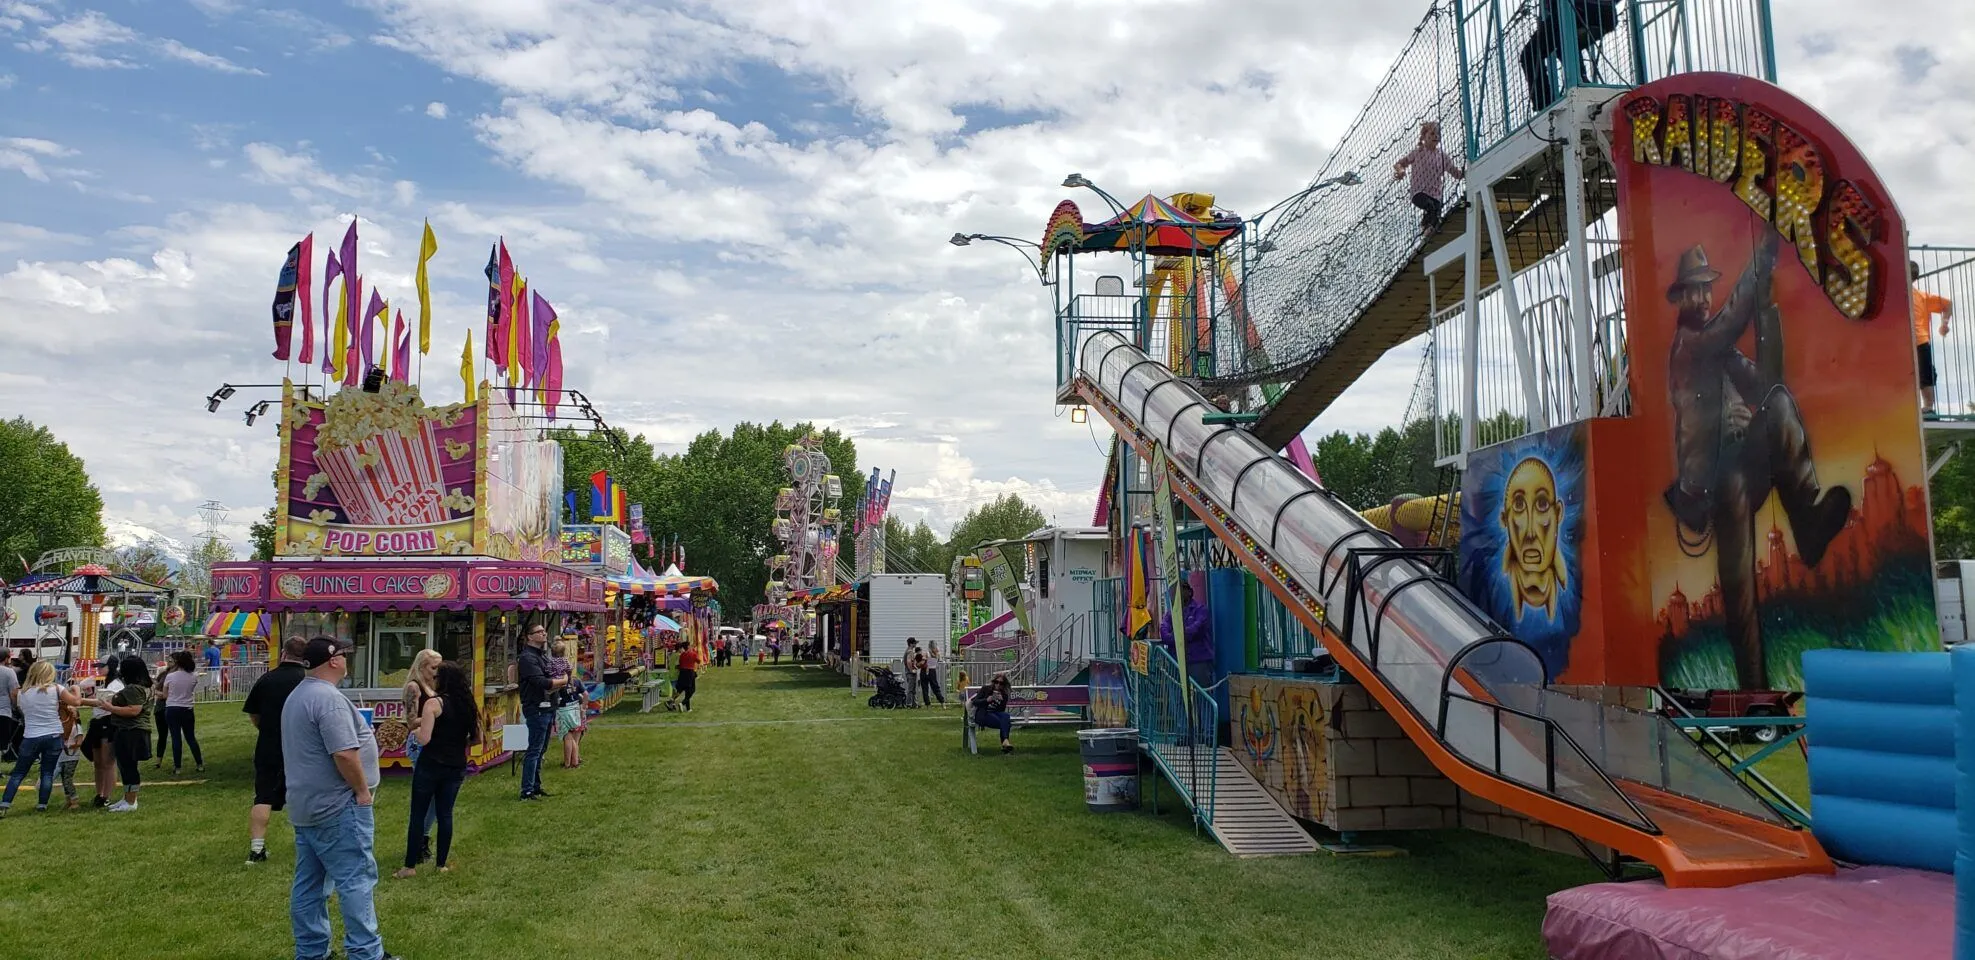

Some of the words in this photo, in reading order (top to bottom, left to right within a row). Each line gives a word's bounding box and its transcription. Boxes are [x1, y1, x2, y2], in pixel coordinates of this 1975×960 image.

[1626, 93, 1881, 320] RAIDERS
[384, 481, 412, 512] POP
[399, 485, 439, 525] CORN
[323, 528, 370, 553] POP
[374, 528, 438, 553] CORN
[218, 575, 252, 594] DRINKS
[302, 576, 366, 593] FUNNEL
[372, 576, 427, 593] CAKES
[476, 575, 516, 593] COLD
